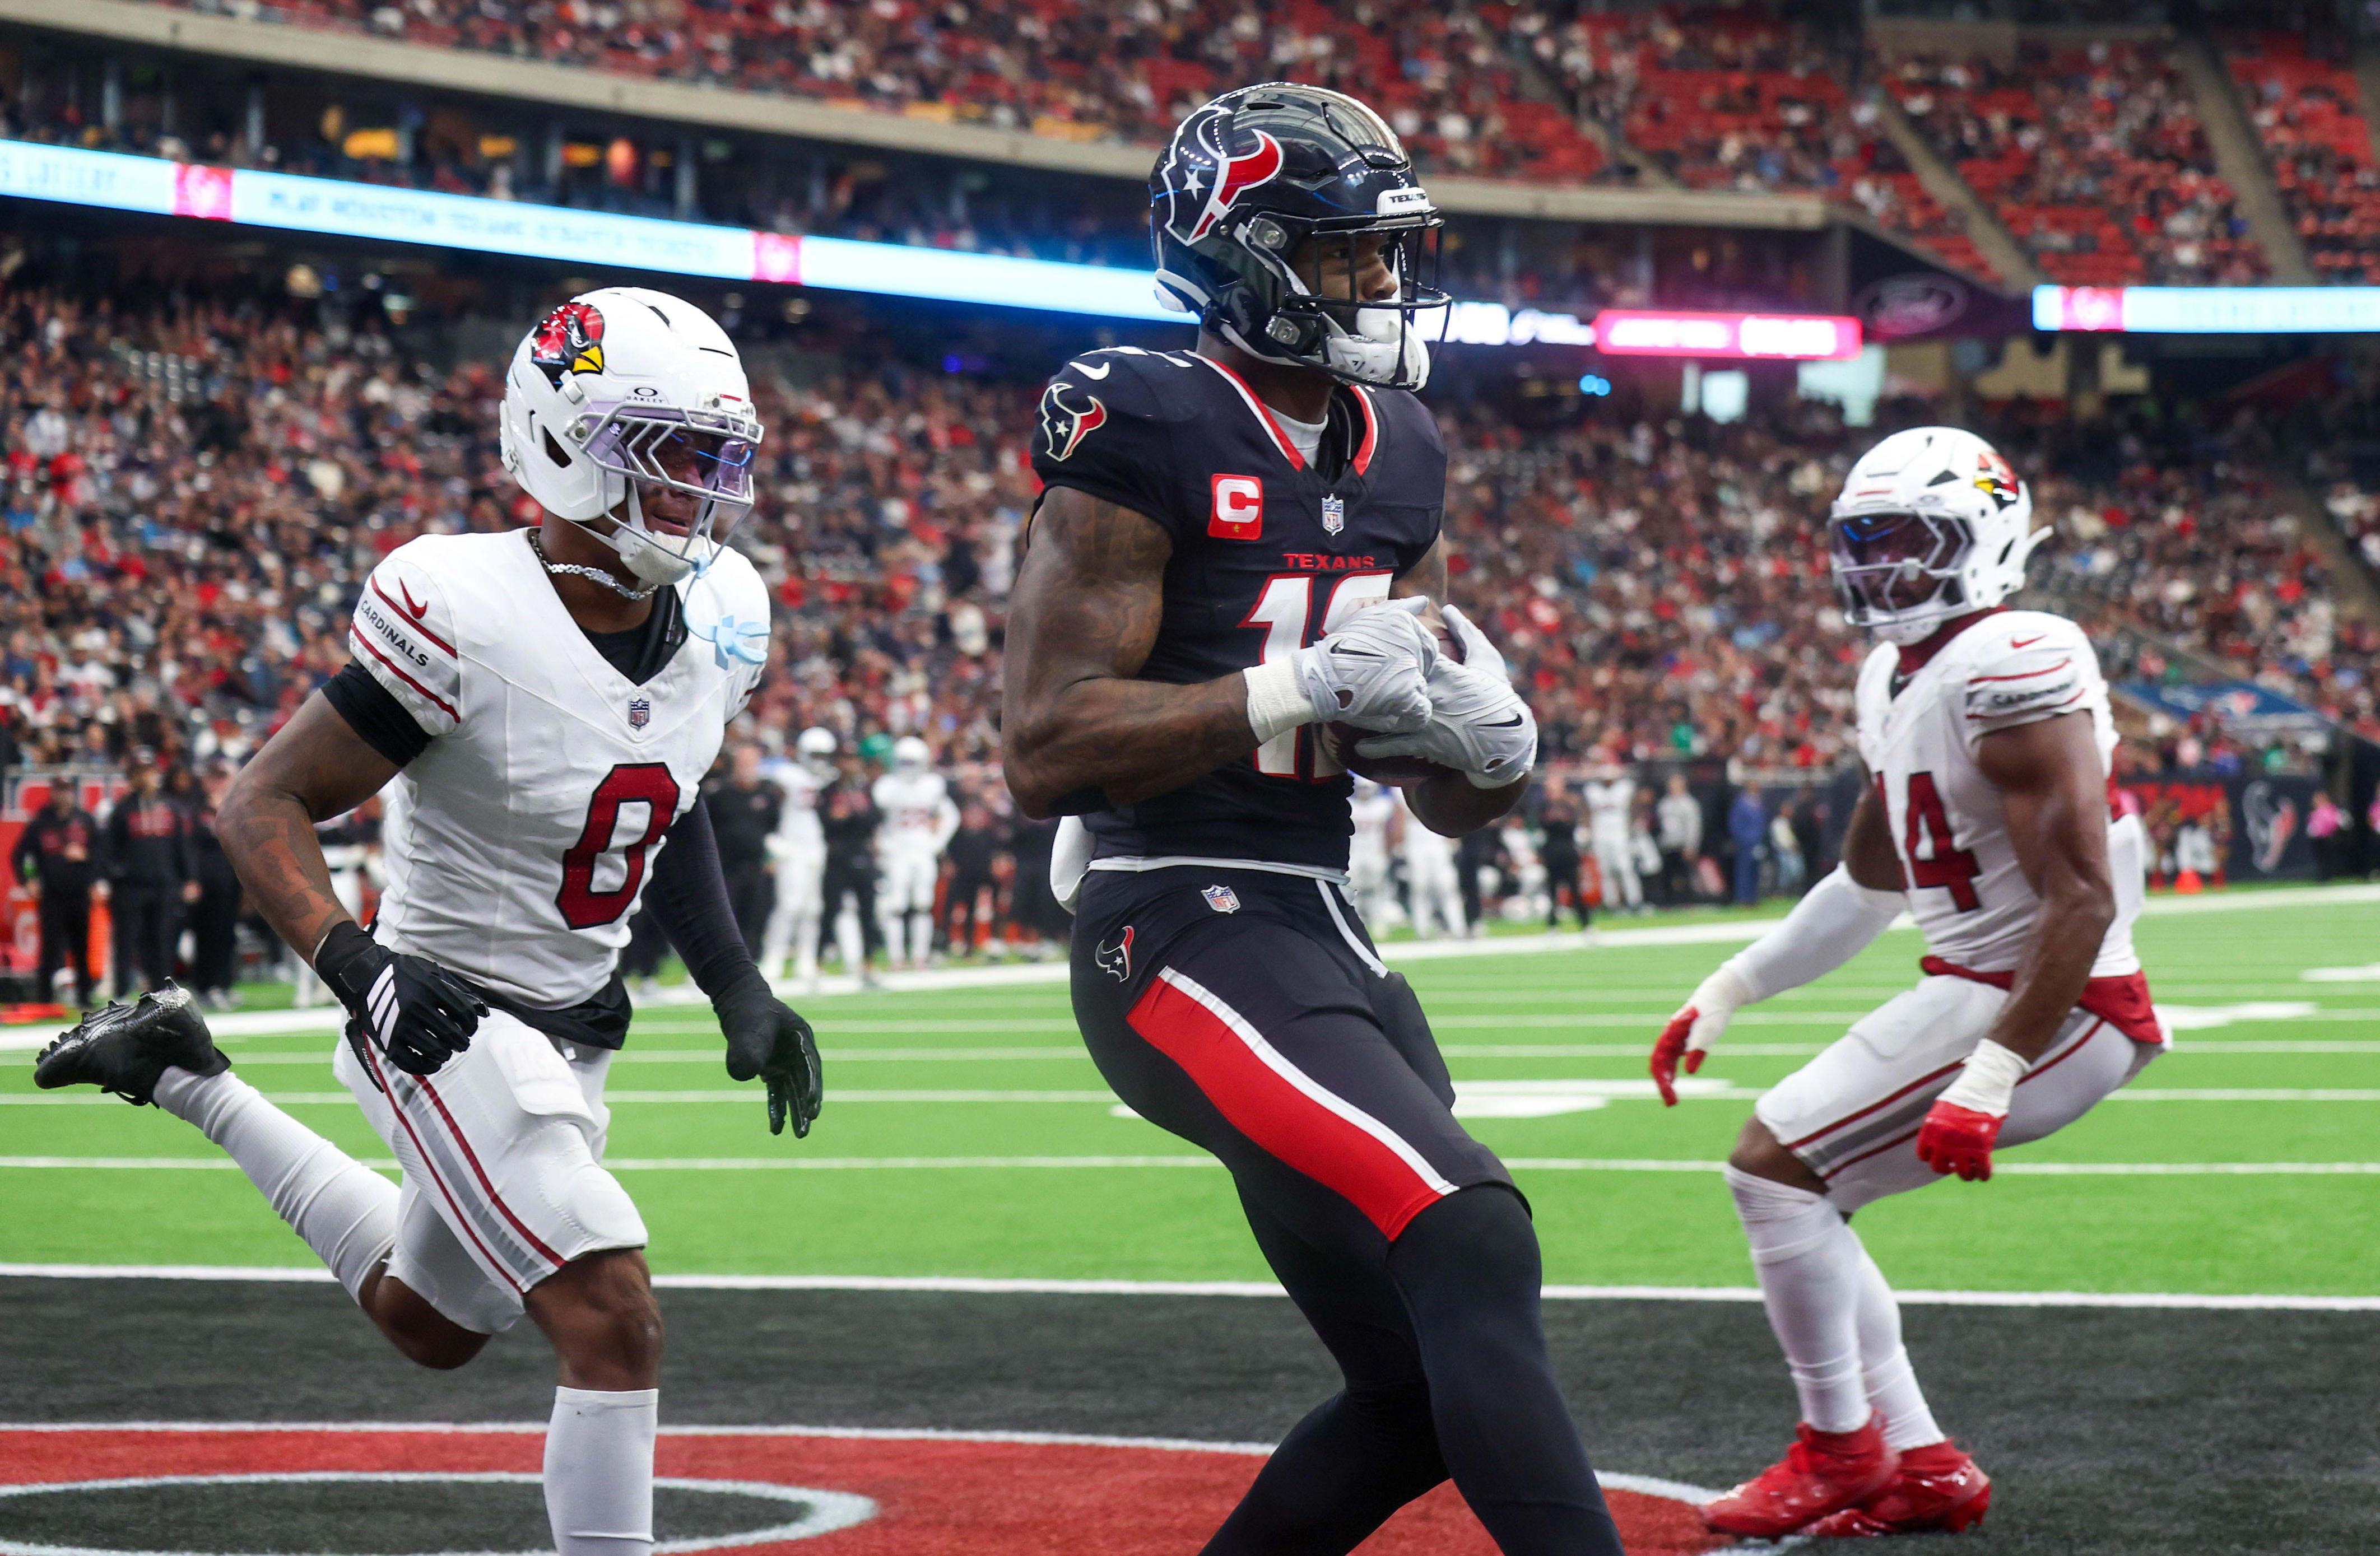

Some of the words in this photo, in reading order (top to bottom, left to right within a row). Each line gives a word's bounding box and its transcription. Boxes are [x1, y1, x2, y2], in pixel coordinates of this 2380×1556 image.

[1216, 479, 1259, 523] C
[1282, 553, 1375, 570] TEXANS
[361, 600, 429, 667] CARDINALS
[555, 762, 680, 930] 0
[1876, 771, 1982, 913] 4
